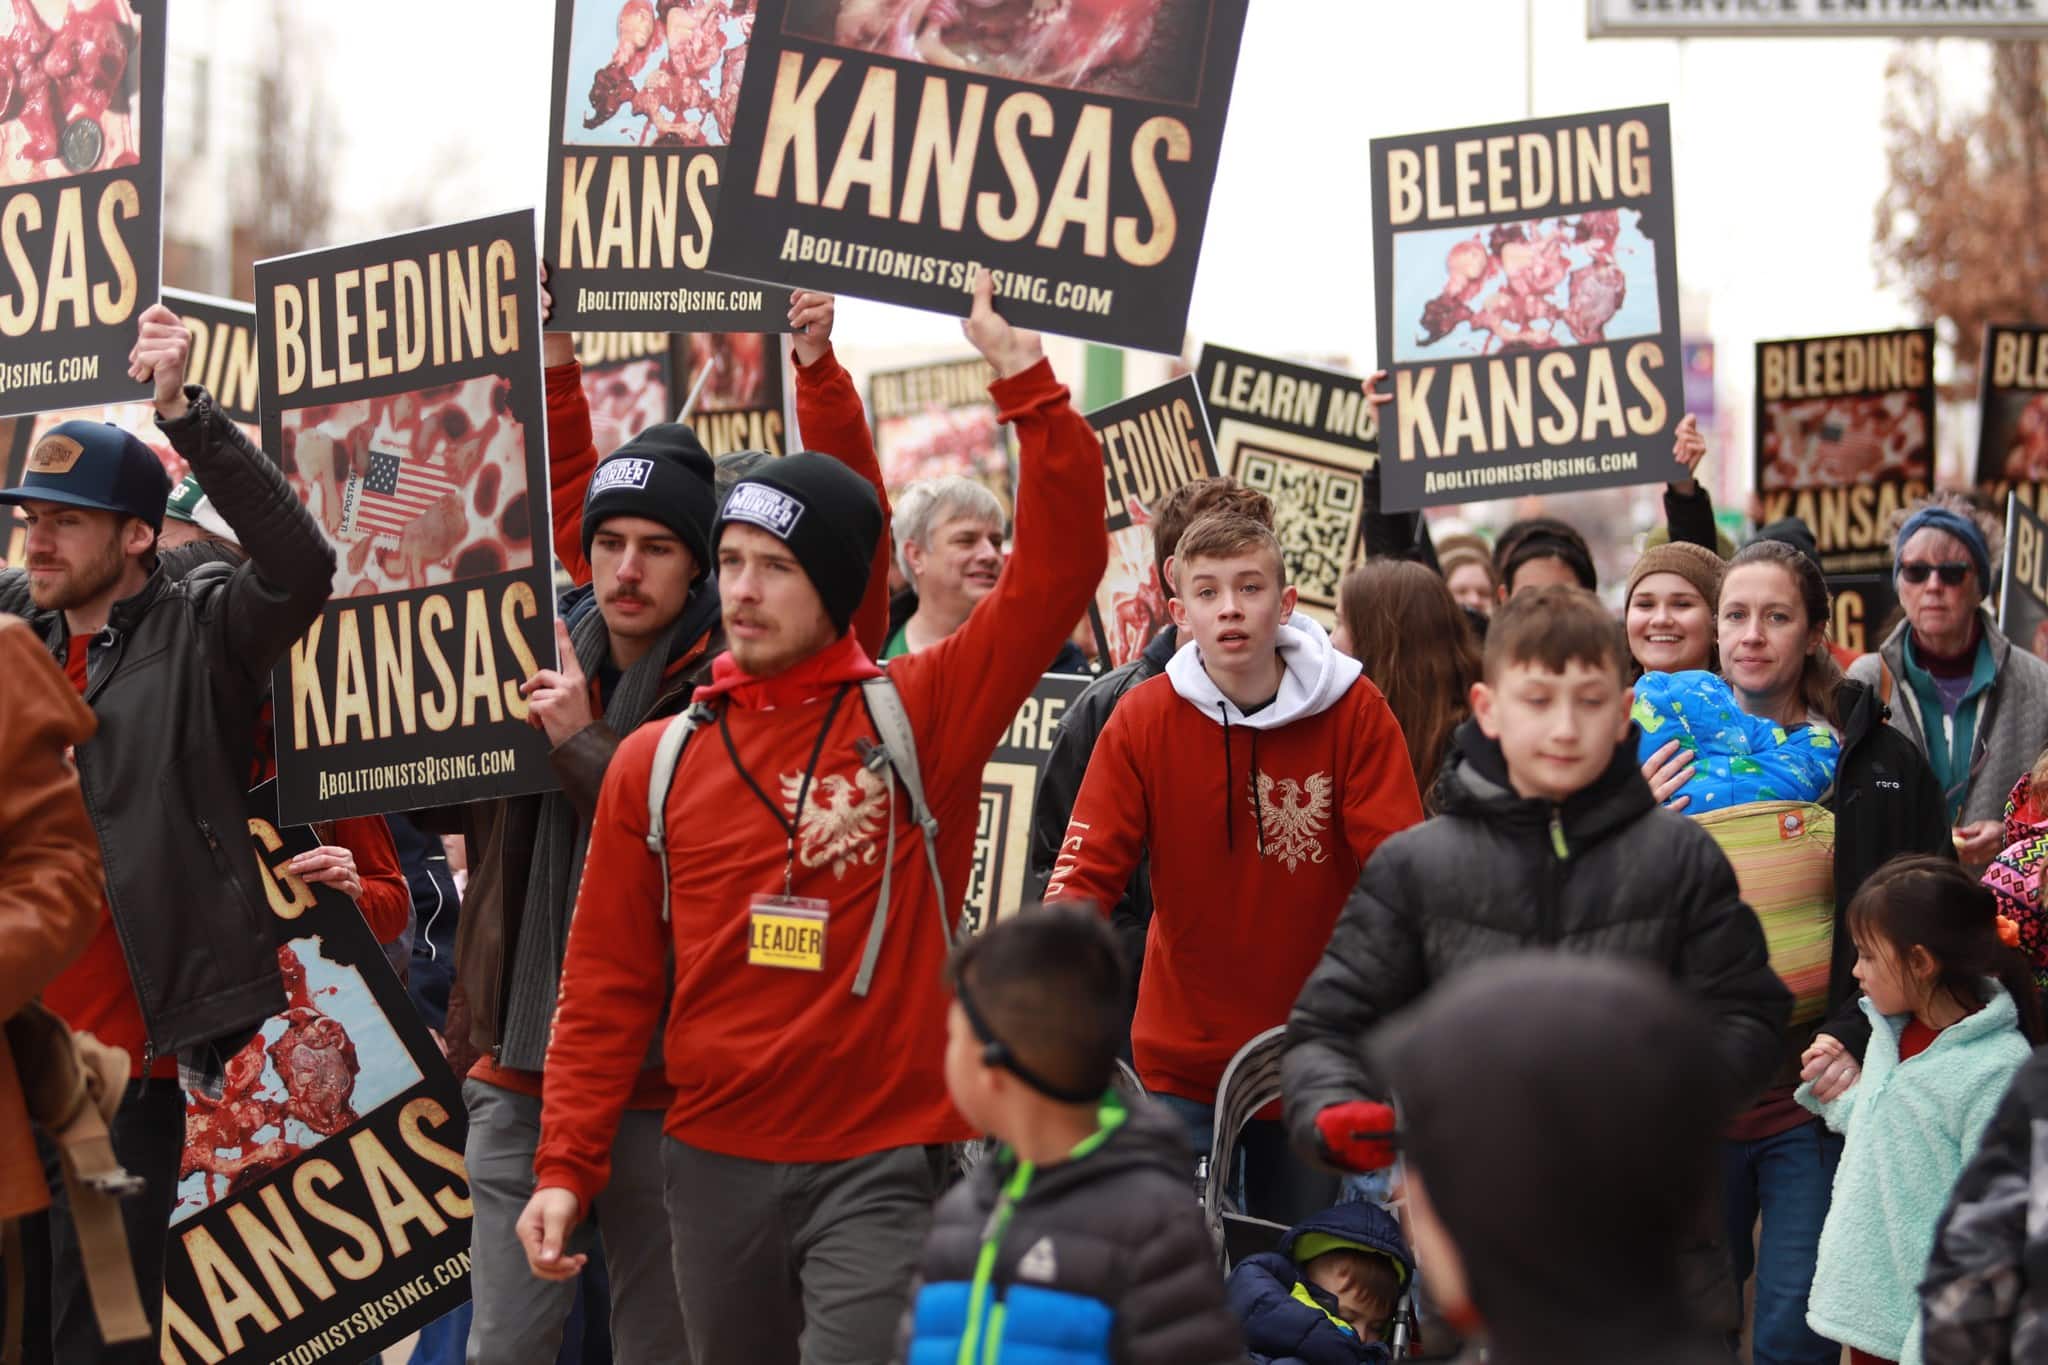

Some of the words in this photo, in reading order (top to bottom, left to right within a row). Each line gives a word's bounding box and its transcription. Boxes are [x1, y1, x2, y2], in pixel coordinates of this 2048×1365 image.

[754, 50, 1193, 268] KANSAS
[1387, 120, 1651, 225] BLEEDING
[0, 179, 140, 337] SAS
[780, 228, 1113, 316] ABOLITIONISTSRSING.COM
[274, 239, 519, 395] BLEEDING
[577, 287, 762, 313] ABOLITIONISTSRISING.COM
[1209, 360, 1322, 428] LEARN
[1762, 332, 1926, 400] BLEEDING
[1396, 342, 1667, 462] KANSAS
[1424, 452, 1638, 494] ABOLITIONISTSRISING.COM
[728, 492, 793, 527] MURDER
[290, 581, 538, 750] KANSAS
[997, 697, 1065, 750] RE
[319, 749, 516, 801] ABOLITIONISTSRISING.COM
[751, 922, 822, 954] LEADER
